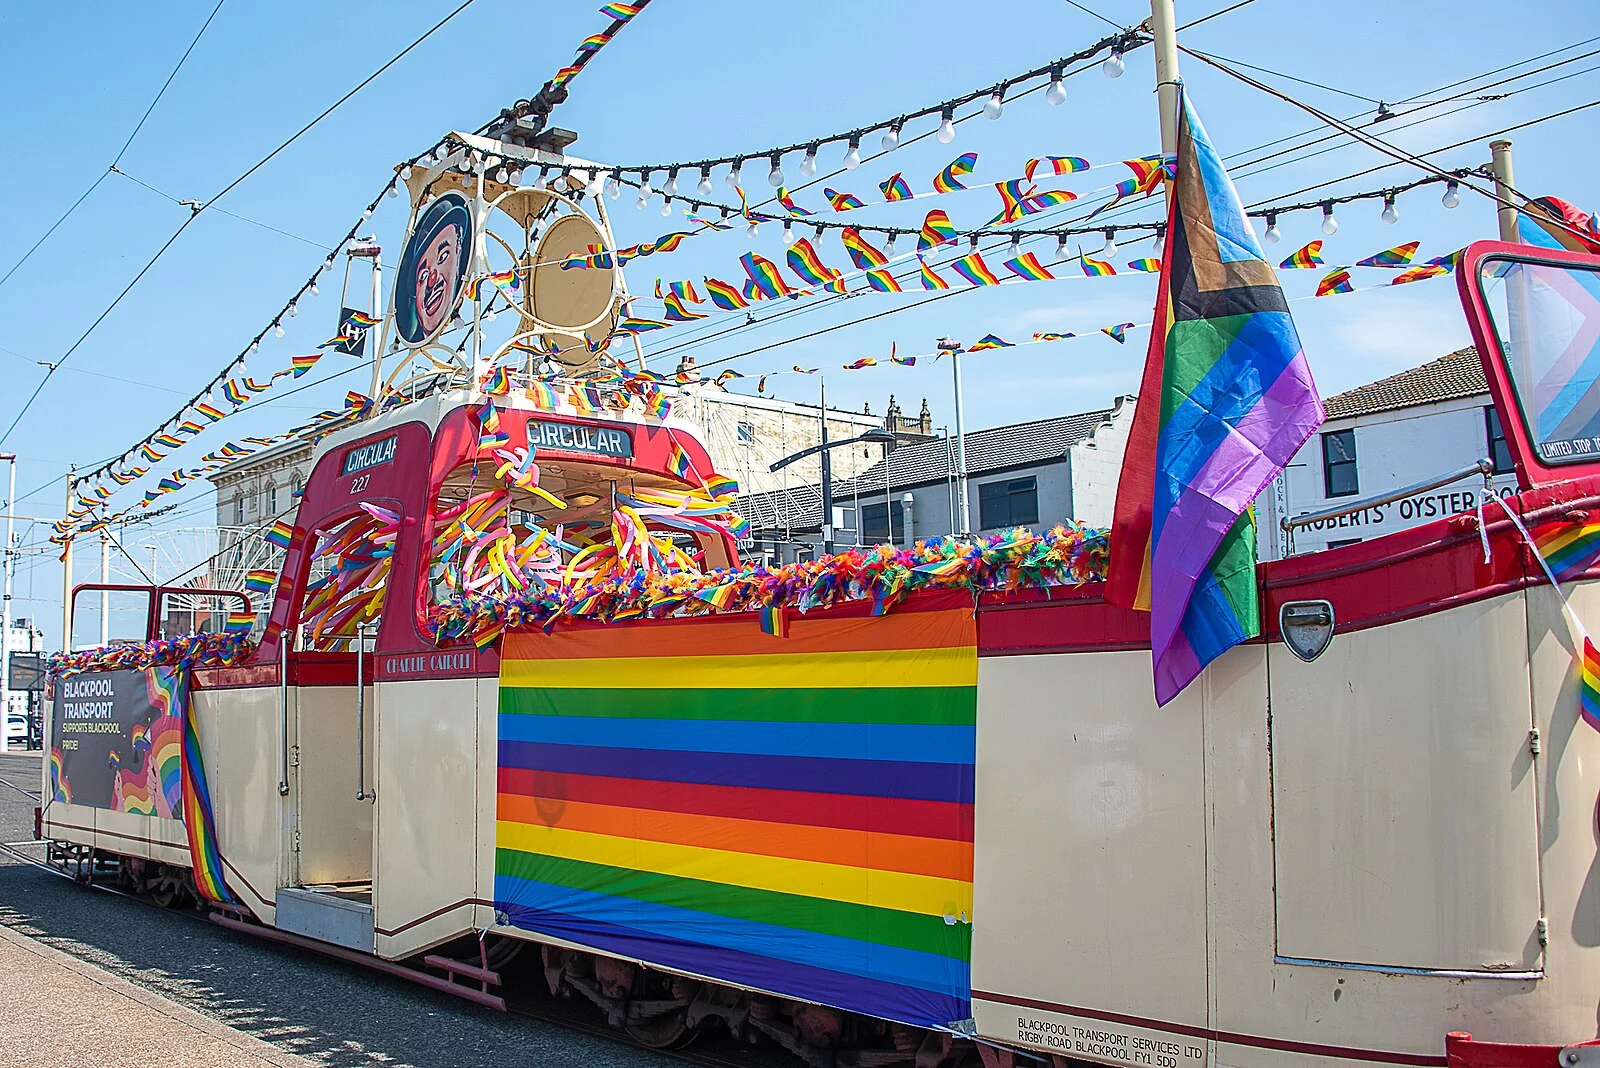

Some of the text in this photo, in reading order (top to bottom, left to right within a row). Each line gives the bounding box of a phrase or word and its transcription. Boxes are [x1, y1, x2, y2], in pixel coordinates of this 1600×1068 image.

[527, 421, 623, 453] CIRCULAR
[1541, 441, 1573, 458] LIMITED
[1572, 438, 1592, 454] STOP
[350, 474, 371, 494] 227
[1399, 491, 1476, 520] OYSTER
[386, 653, 470, 674] CHARLIE CAIROLI
[64, 679, 114, 698] BLACKPOOL
[63, 701, 114, 719] TRANSPORT
[62, 722, 121, 734] SUPPORTS BLACKPOOL
[1018, 1017, 1203, 1059] BLACKPOOL TRANSPORT SERVICES LTD
[1018, 1030, 1177, 1068] RIGBY ROAD BLACKPOOL FY1 5DD
